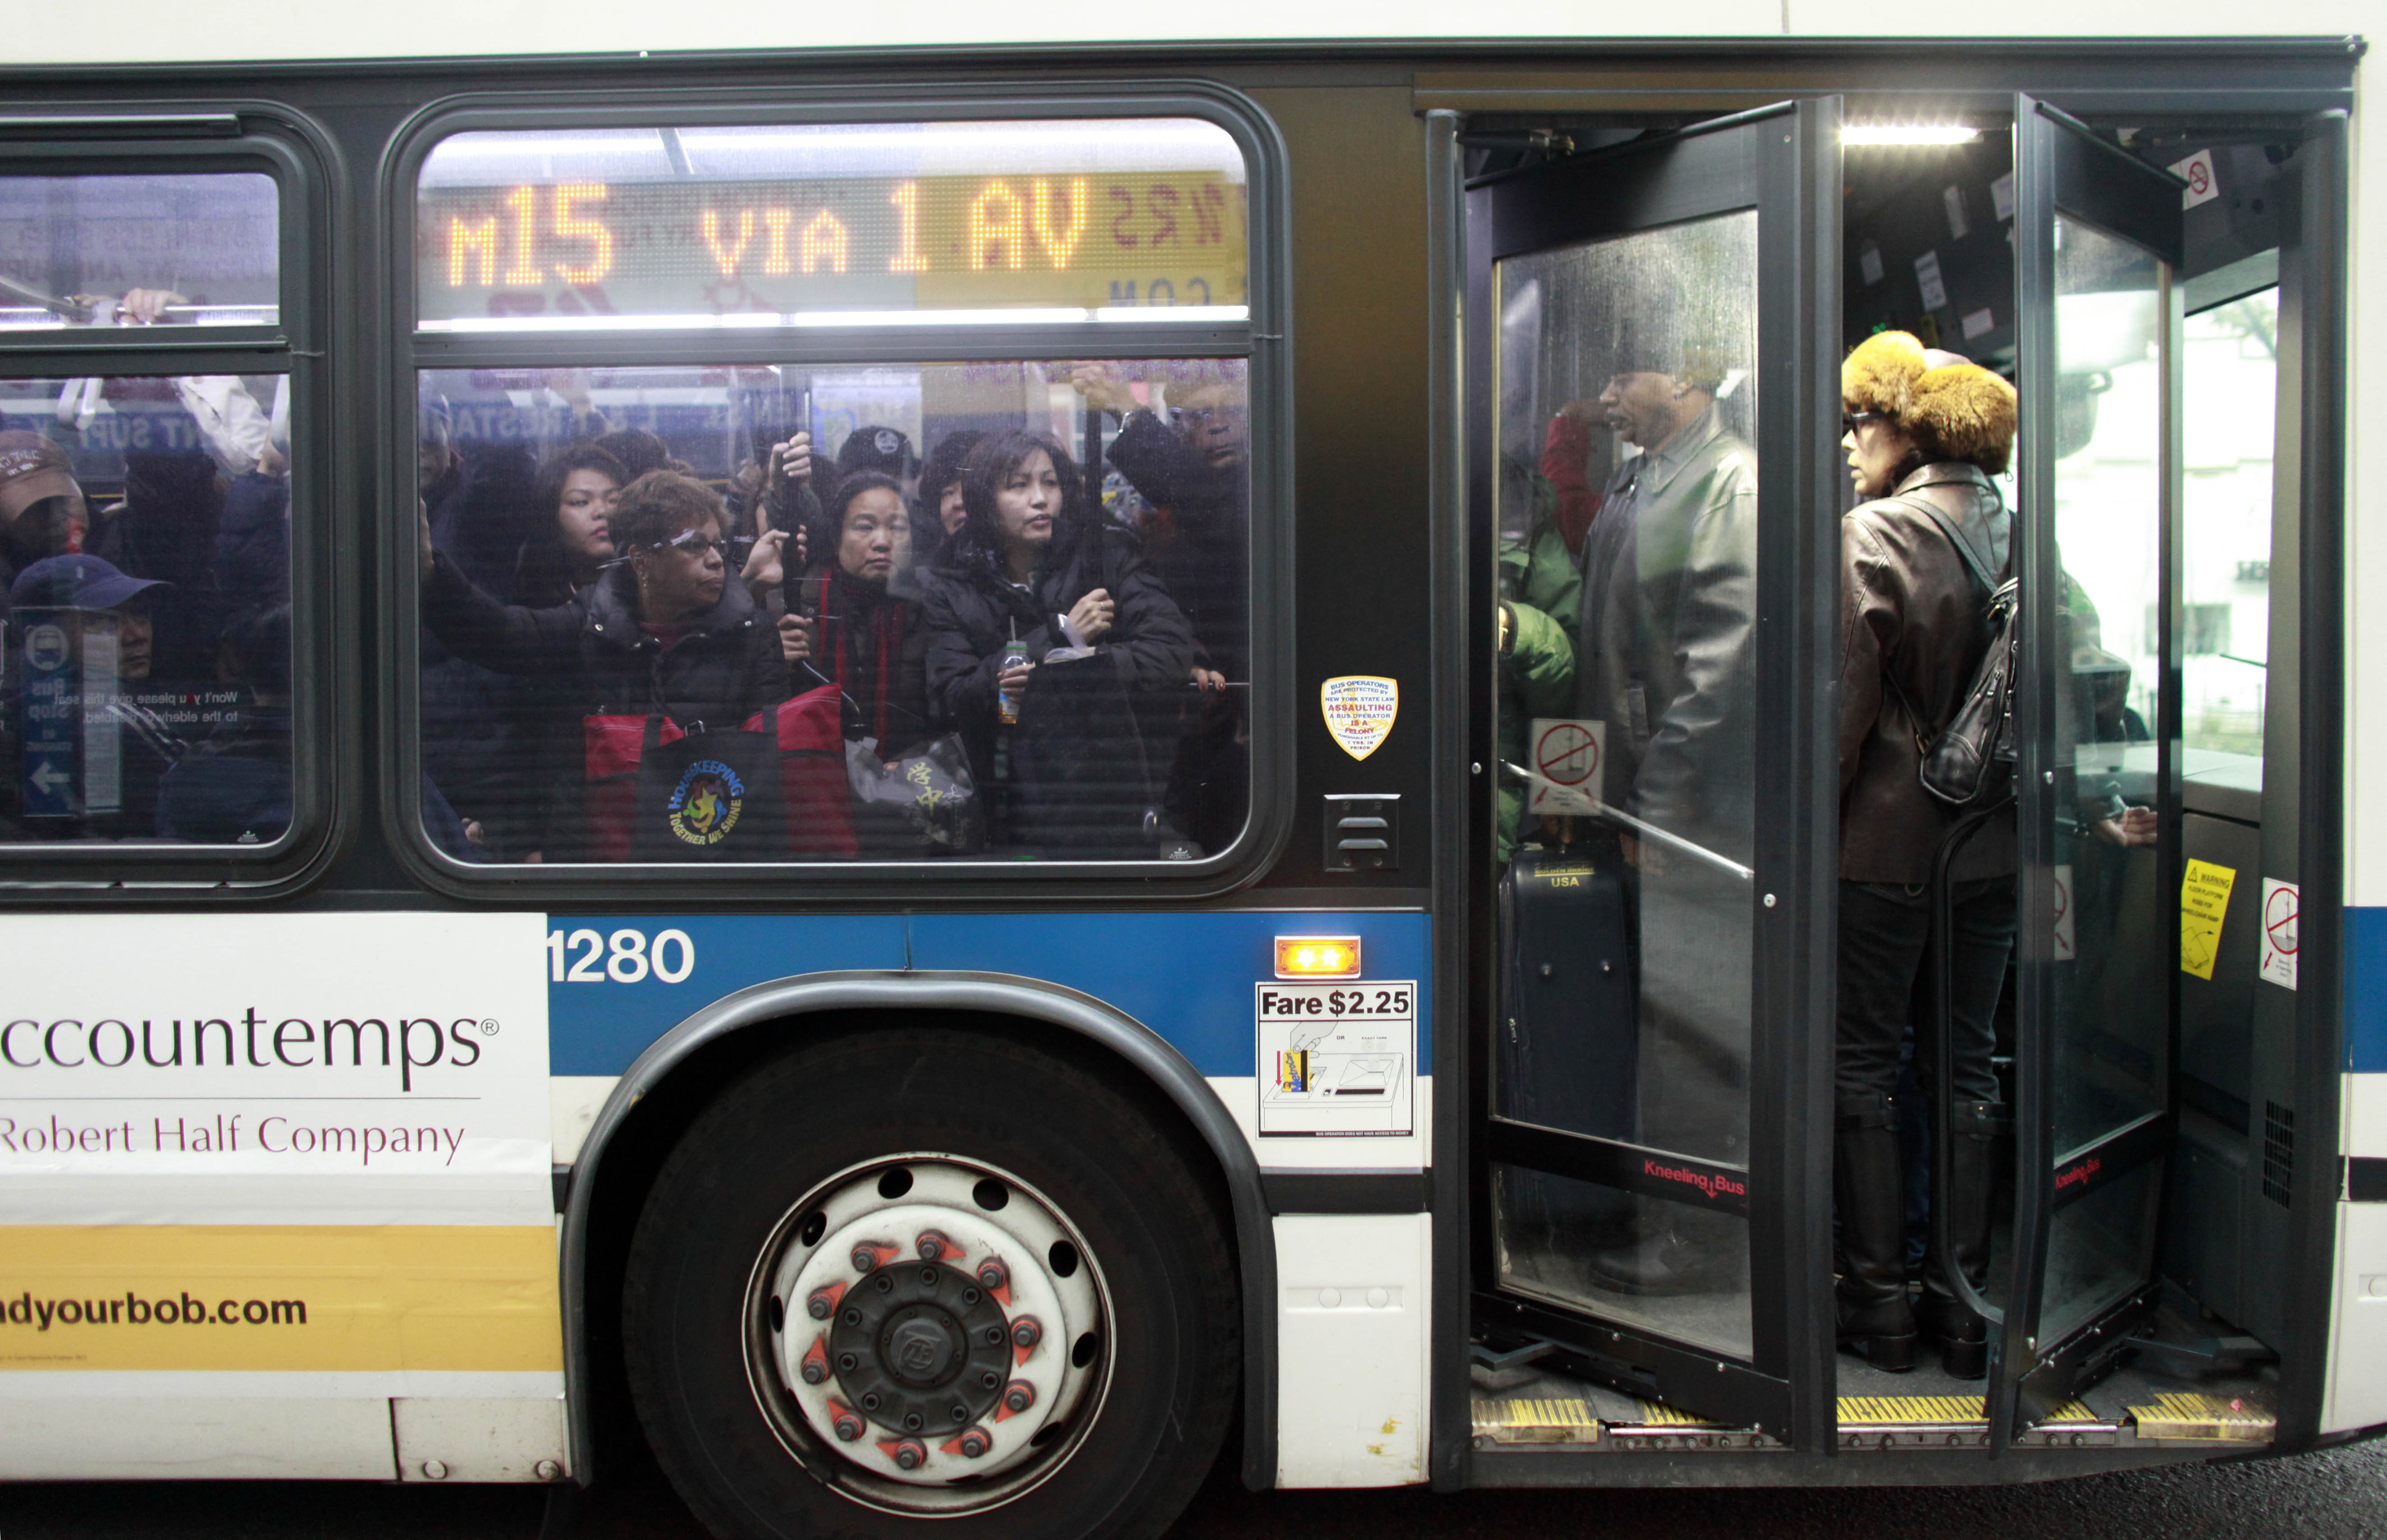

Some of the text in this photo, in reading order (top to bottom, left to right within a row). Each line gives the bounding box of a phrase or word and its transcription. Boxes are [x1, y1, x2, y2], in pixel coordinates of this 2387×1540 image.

[703, 211, 847, 274] VIA
[889, 182, 928, 272] 1
[971, 180, 1087, 270] AV
[1331, 681, 1389, 690] BUS OPERATORS
[668, 760, 745, 809] HOUSEKEEPING
[669, 799, 742, 845] TOGETHER WE SHINE
[1551, 876, 1580, 887] USA
[547, 928, 694, 984] 1280
[1263, 990, 1409, 1017] Fare $2.25
[1285, 1052, 1301, 1092] MetroCard
[155, 1114, 241, 1152] Half
[258, 1116, 465, 1166] Company
[1644, 1160, 1746, 1195] Kneeling Bus
[0, 1291, 307, 1332] dyourbob.com
